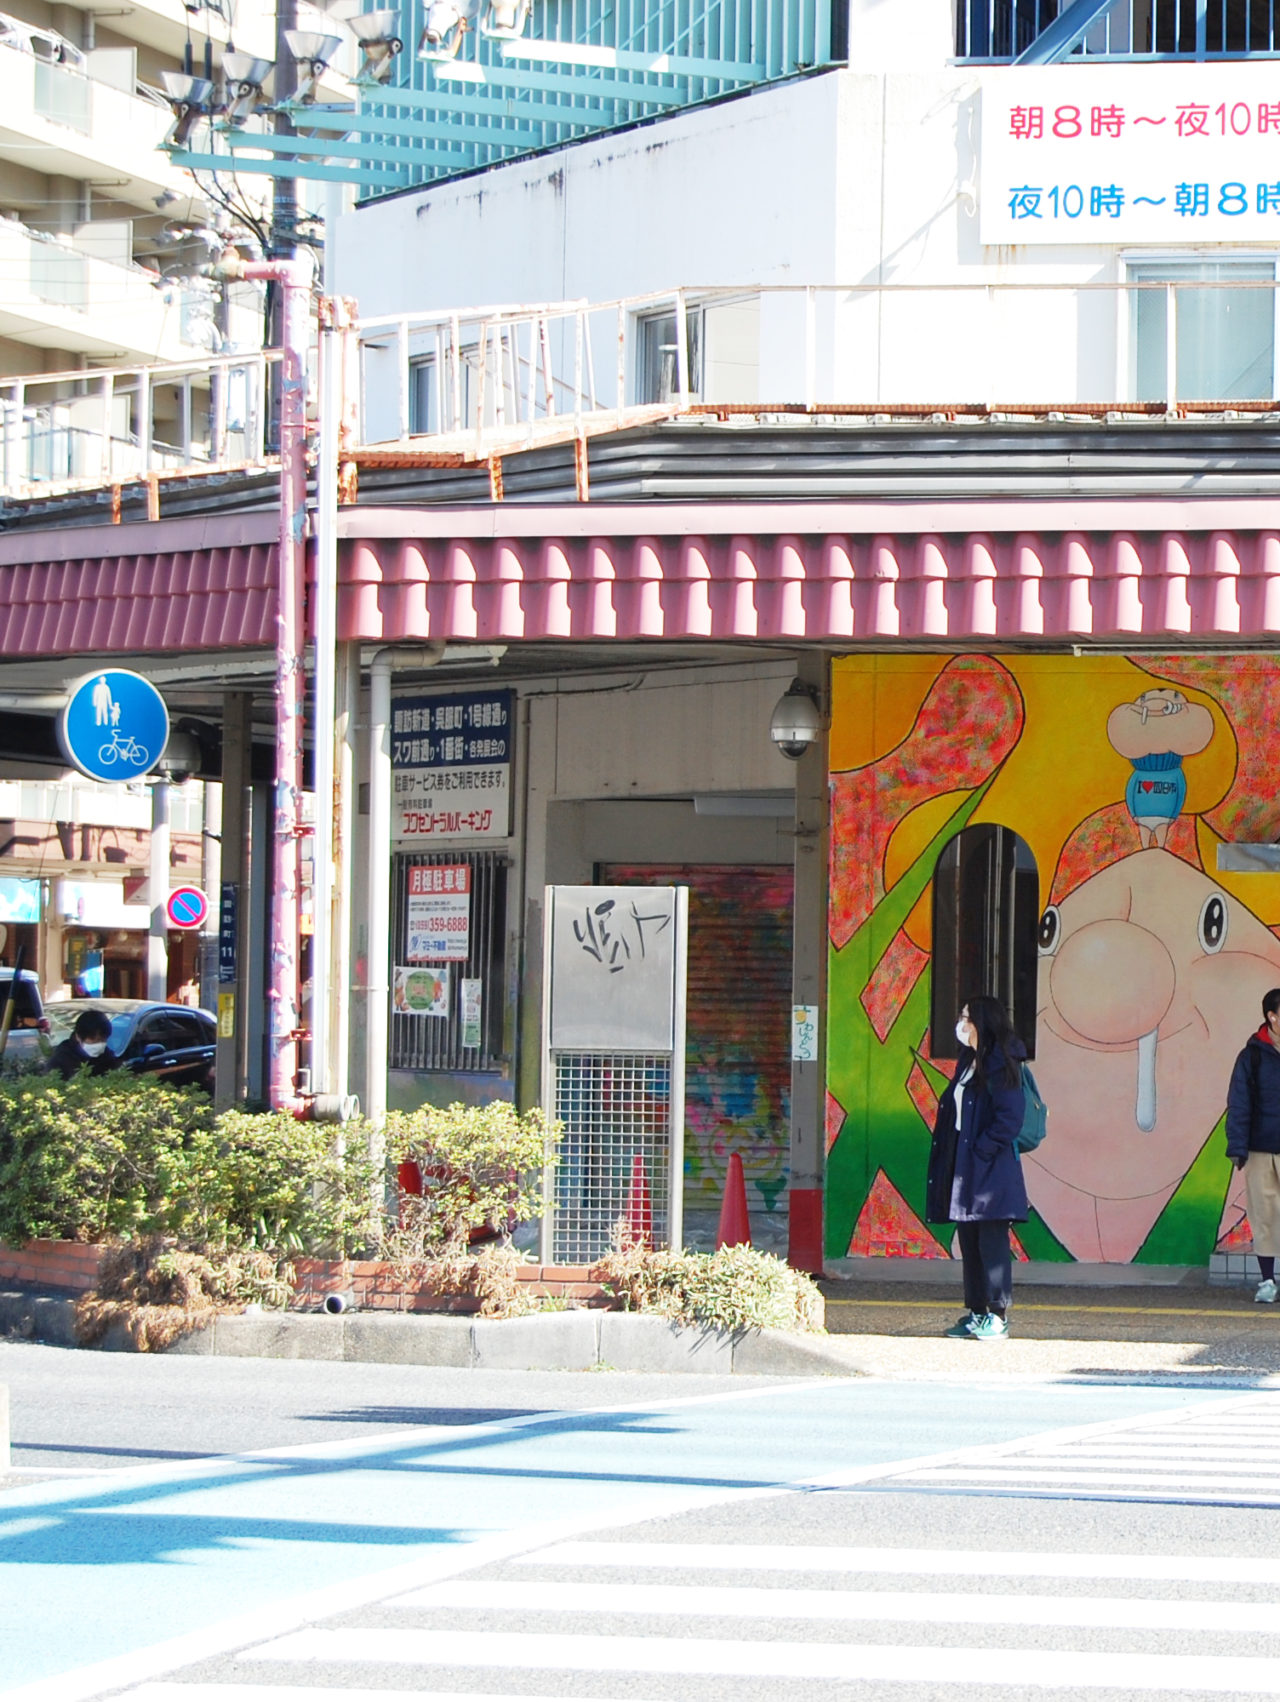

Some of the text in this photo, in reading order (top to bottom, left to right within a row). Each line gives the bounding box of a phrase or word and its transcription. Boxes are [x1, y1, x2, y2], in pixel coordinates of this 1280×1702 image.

[412, 868, 466, 893] 月極駐車場
